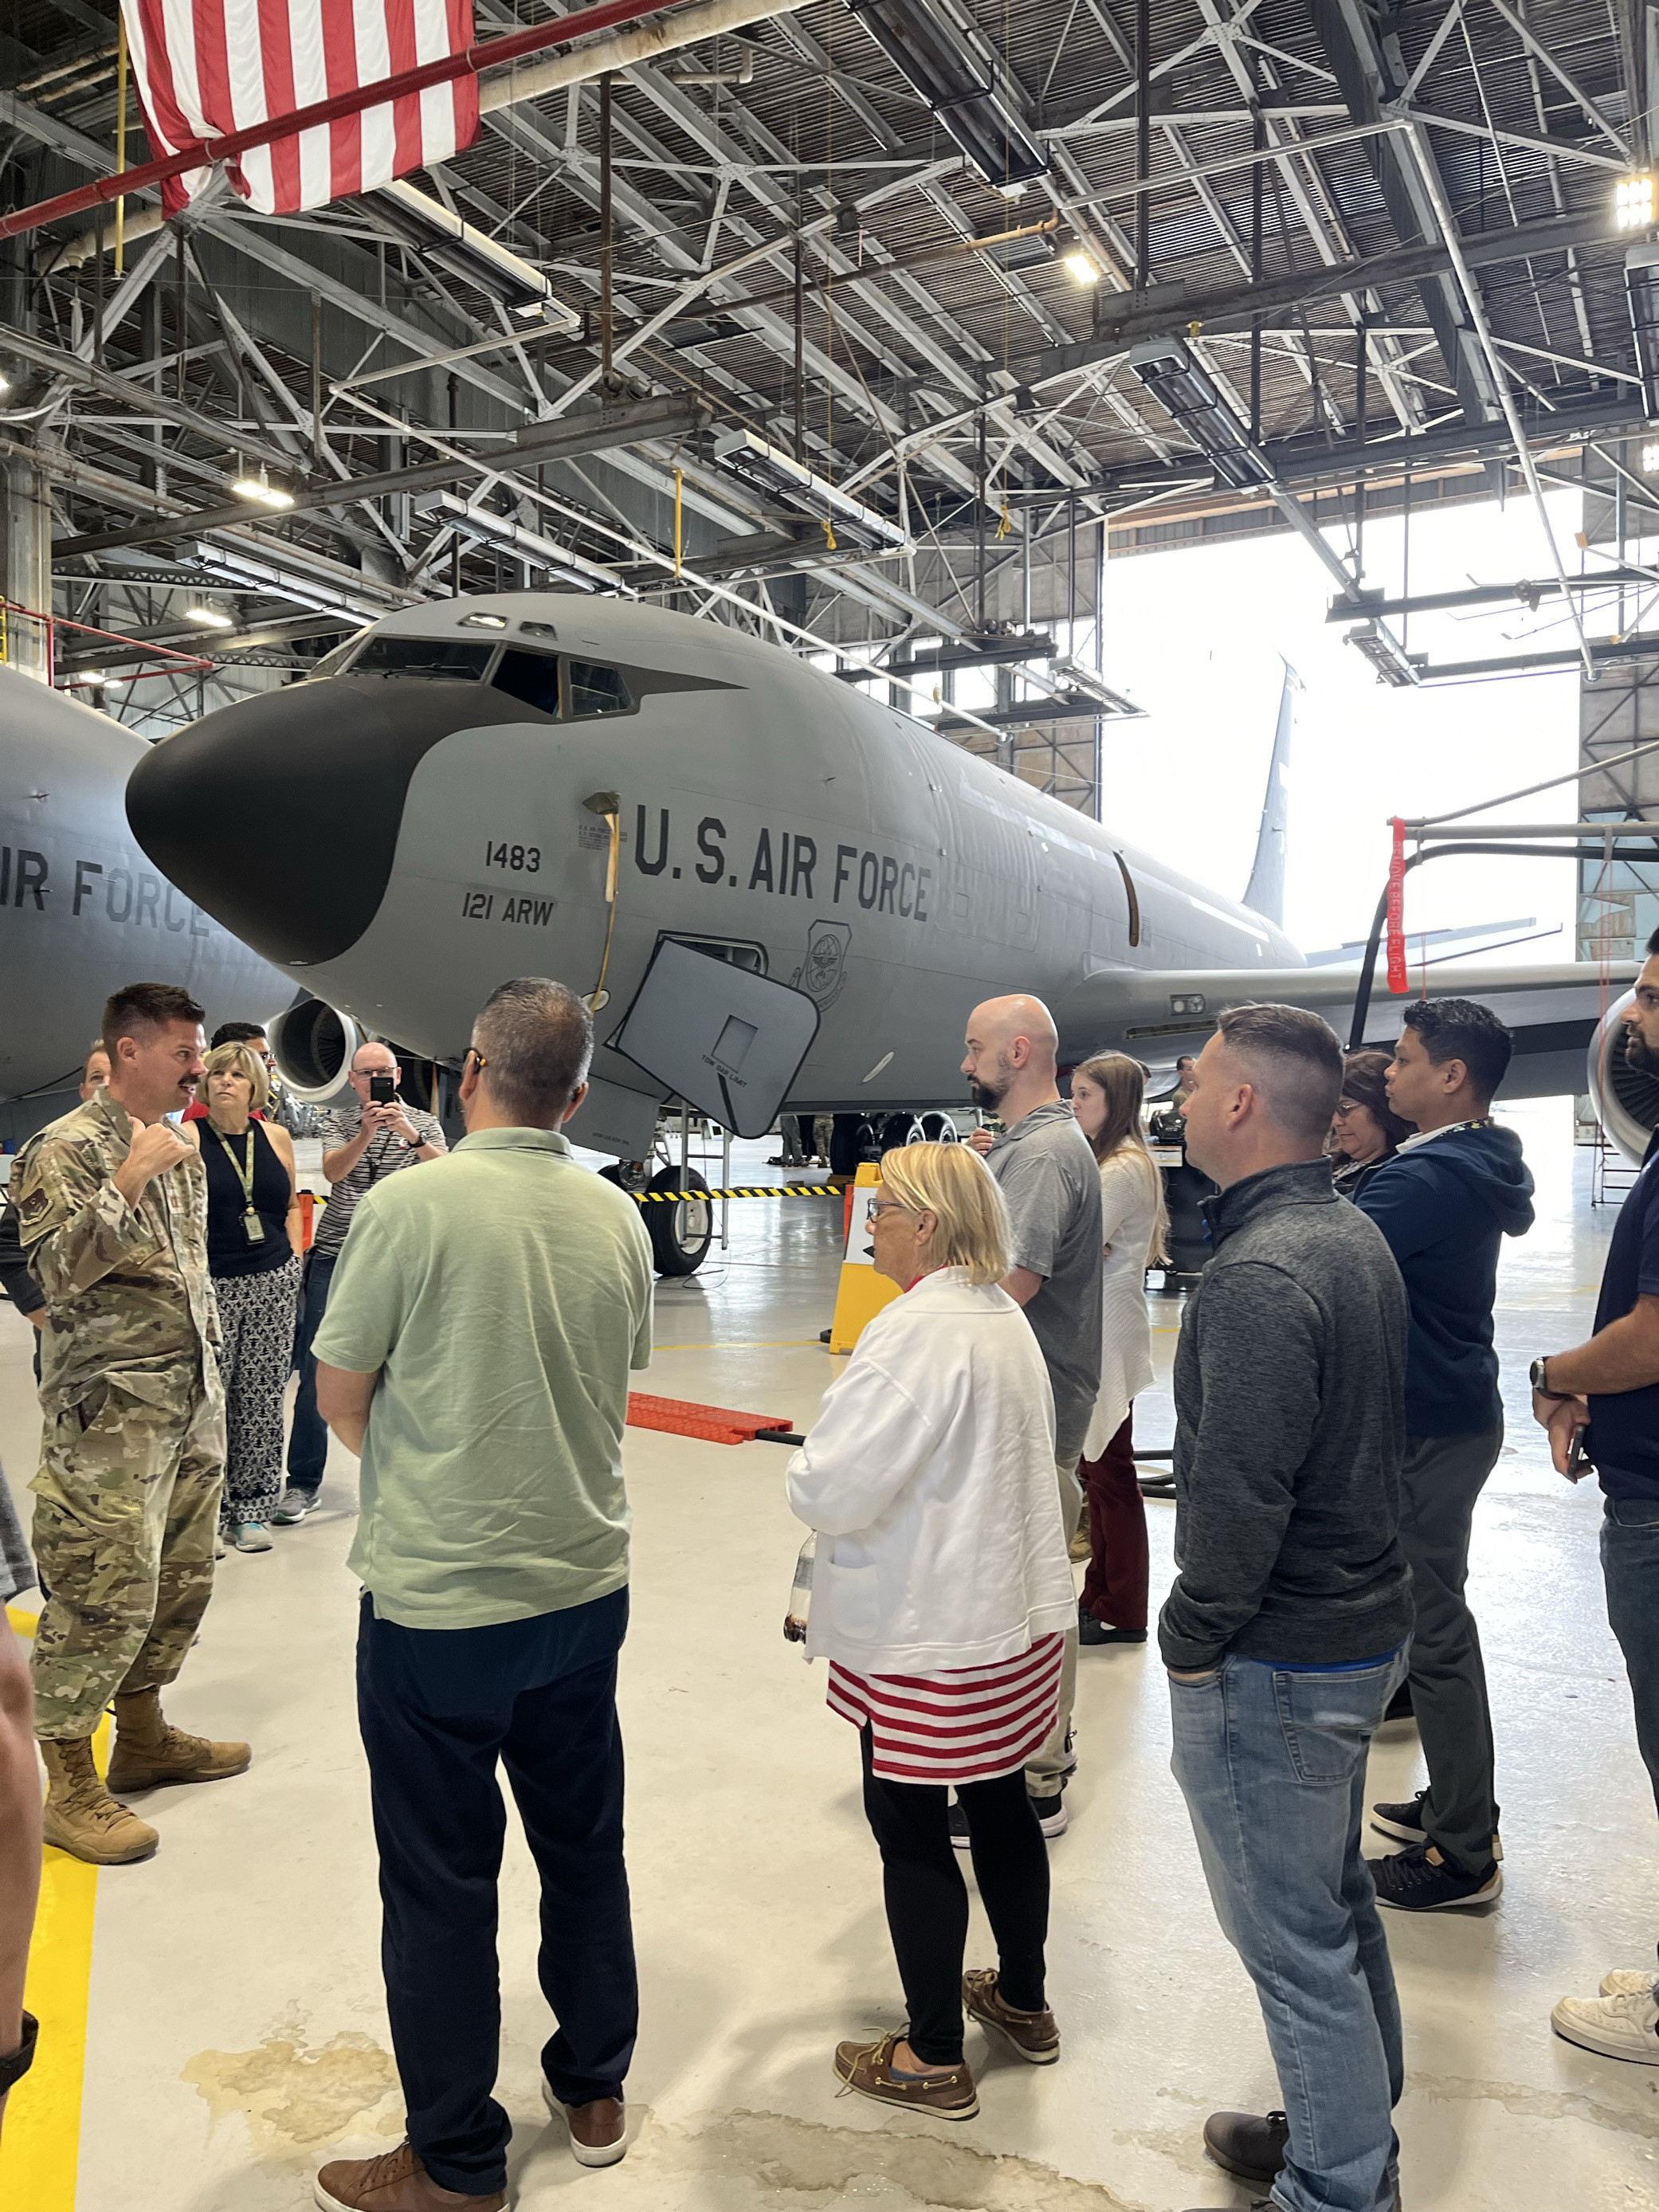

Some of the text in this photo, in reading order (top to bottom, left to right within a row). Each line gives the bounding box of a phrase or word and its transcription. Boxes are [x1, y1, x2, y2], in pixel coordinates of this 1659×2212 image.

[0, 846, 48, 911] IR
[486, 840, 541, 873] 1483
[833, 844, 931, 922] FORCE
[462, 892, 555, 926] 121 ARW
[1389, 841, 1402, 980] REMOVE BEFORE FLIGHT
[701, 1054, 716, 1067] TOW
